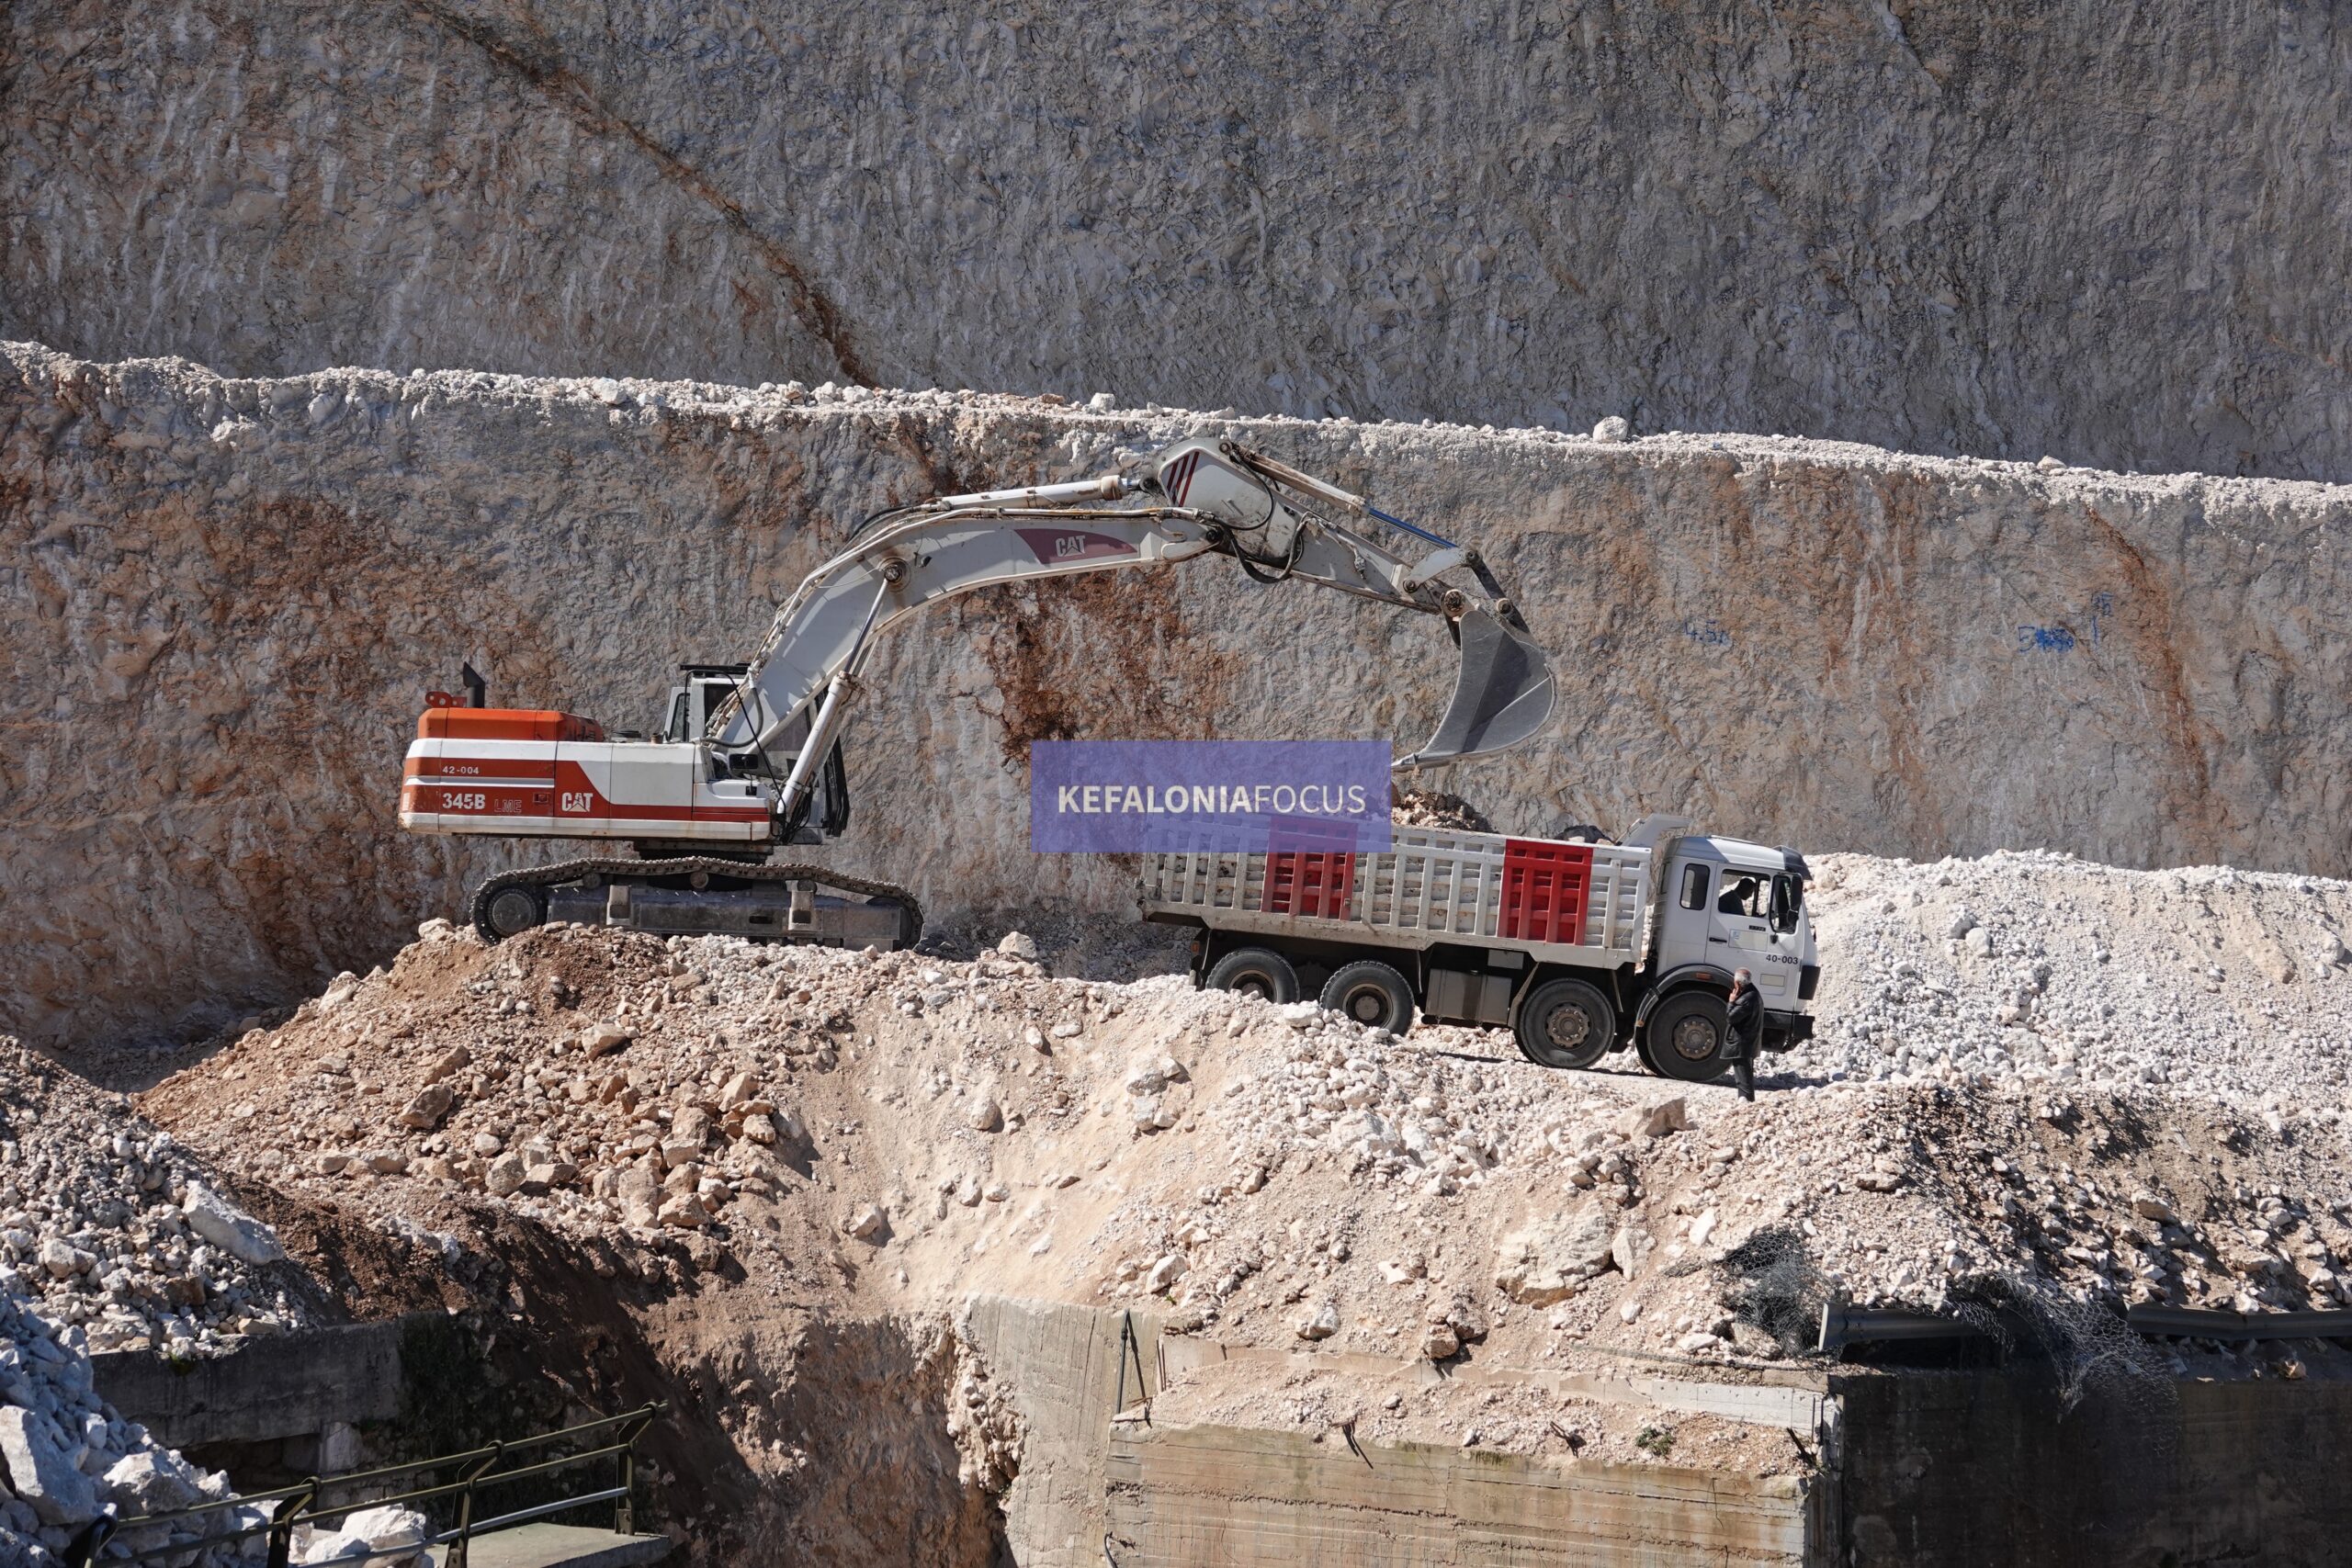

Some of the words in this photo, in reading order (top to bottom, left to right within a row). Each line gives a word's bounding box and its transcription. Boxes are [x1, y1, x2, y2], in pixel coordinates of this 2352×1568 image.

[1056, 535, 1086, 558] CAT
[442, 766, 480, 774] 42-004
[442, 792, 486, 810] 345B
[493, 798, 523, 813] LME
[561, 792, 594, 813] CAT
[1766, 954, 1798, 964] 40-003
